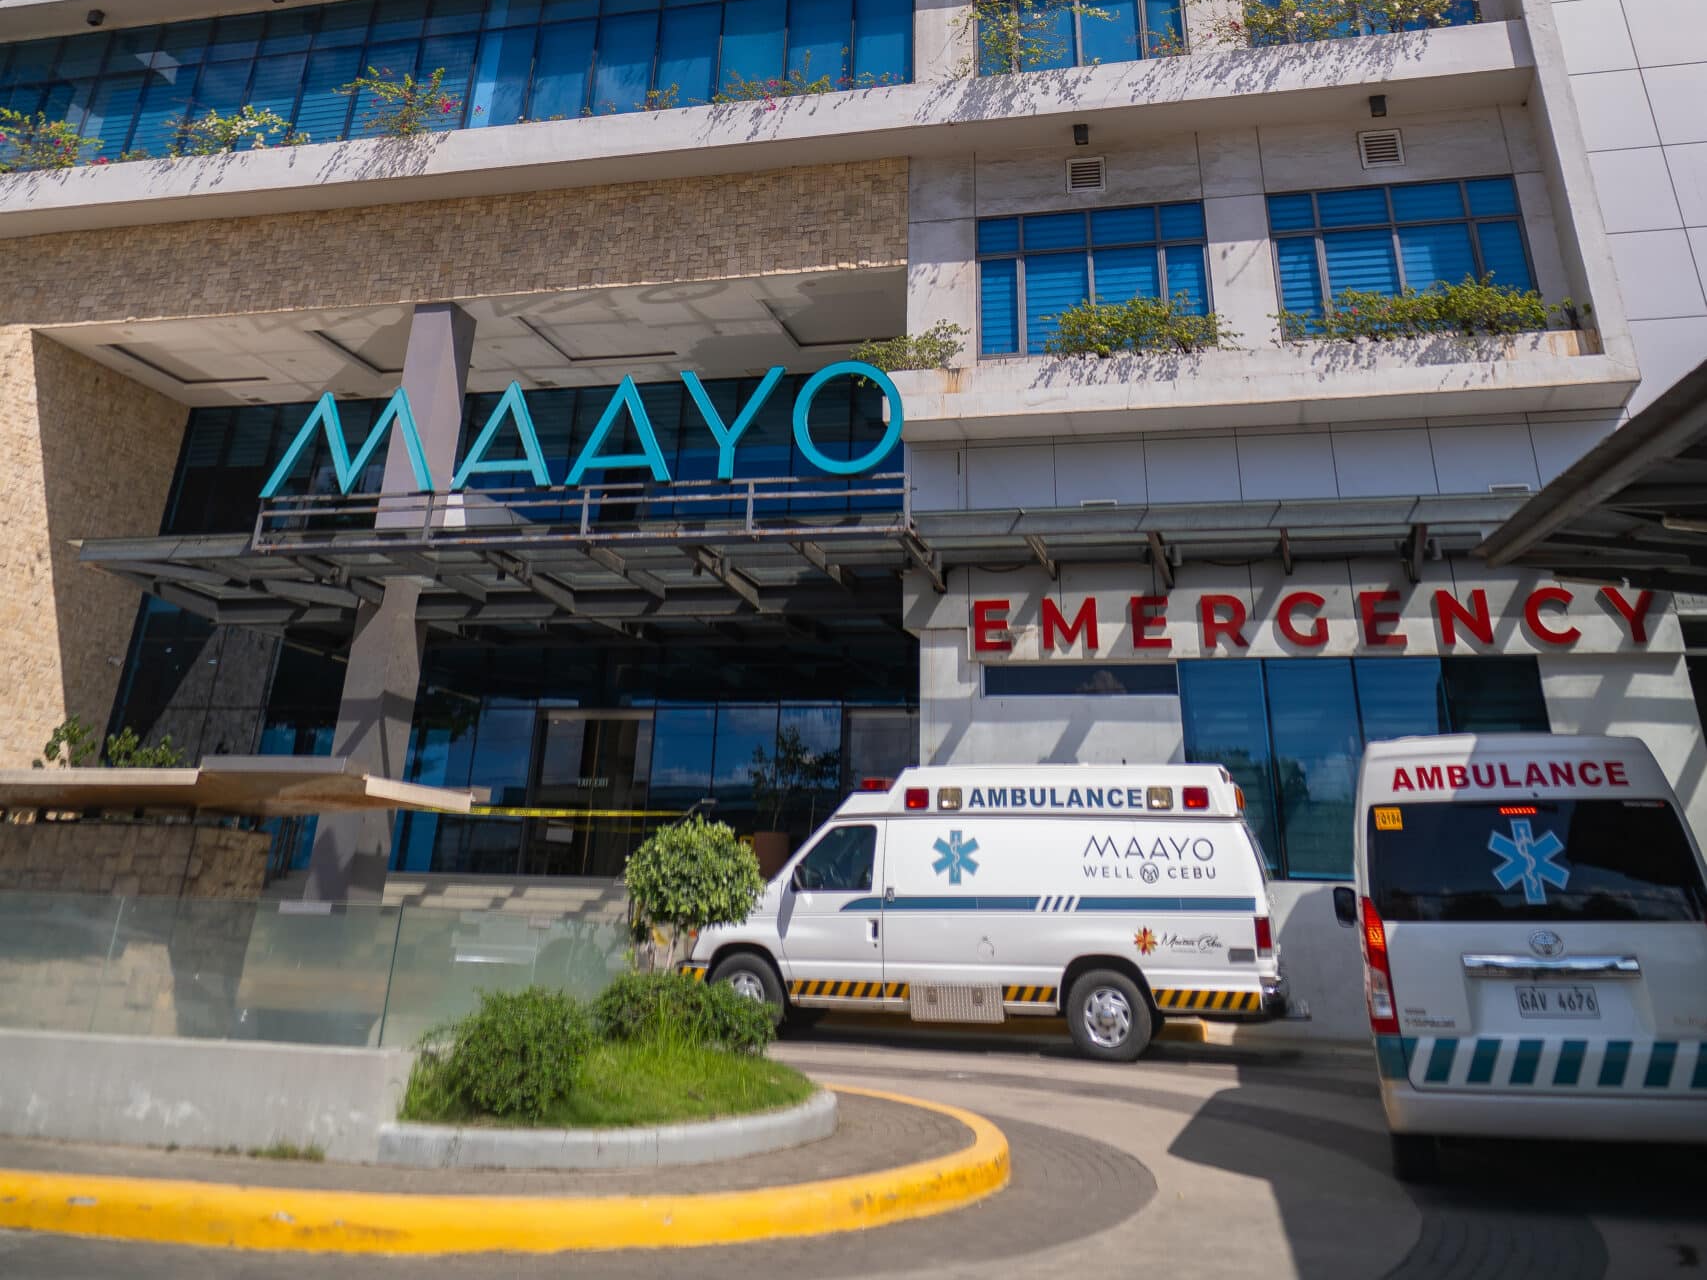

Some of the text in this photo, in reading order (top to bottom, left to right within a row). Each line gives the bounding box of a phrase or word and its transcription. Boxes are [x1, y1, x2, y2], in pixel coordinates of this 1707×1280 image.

[258, 360, 903, 498] MAAYO
[974, 587, 1653, 652] EMERGENCY
[1393, 761, 1629, 792] AMBULANCE
[968, 787, 1143, 808] AMBULANCE
[1083, 835, 1214, 861] MAAYO
[1083, 865, 1216, 880] WELL CEBU
[1520, 991, 1547, 1011] GAV
